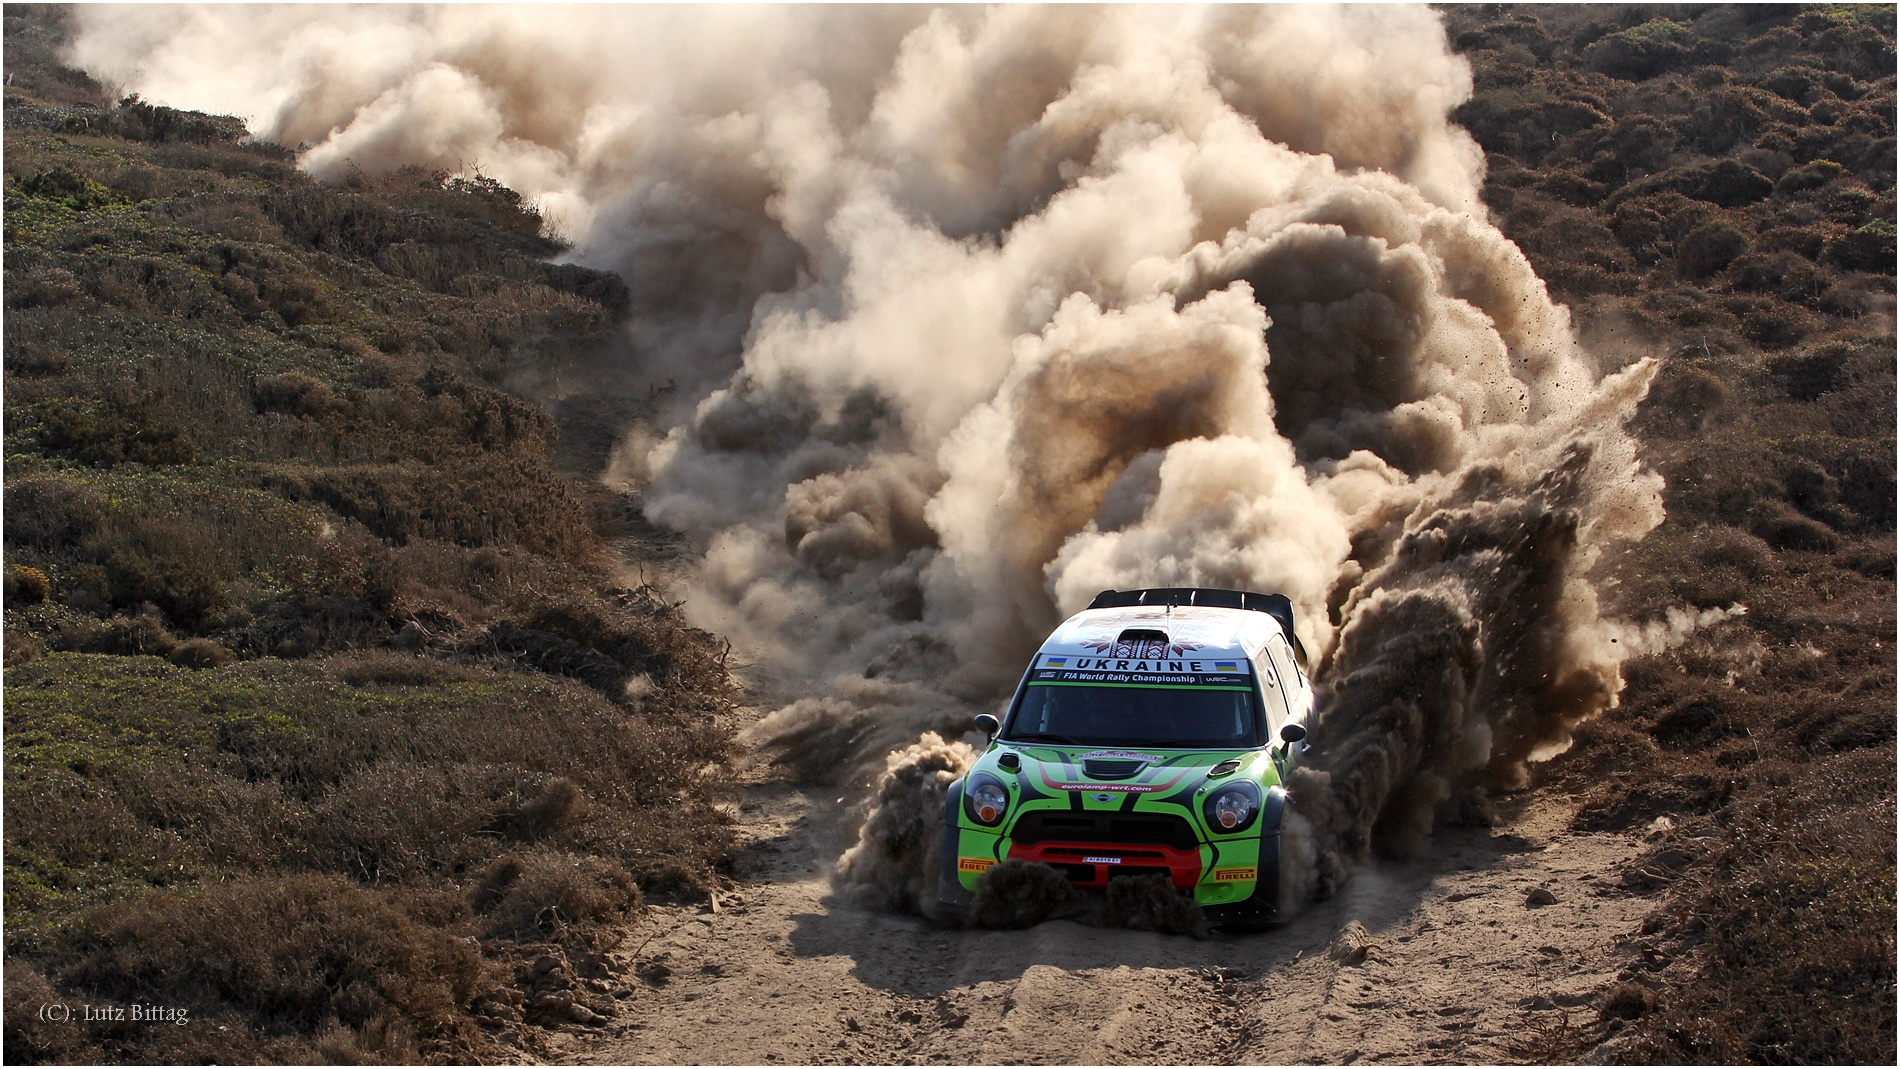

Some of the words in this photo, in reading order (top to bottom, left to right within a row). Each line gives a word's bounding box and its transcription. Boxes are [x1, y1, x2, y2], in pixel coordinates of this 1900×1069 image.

[1076, 659, 1203, 671] UKRAINE
[1063, 672, 1078, 680] FIA
[1079, 673, 1104, 681] World
[1106, 673, 1130, 683] Rally
[1132, 674, 1196, 684] Championship
[1061, 783, 1152, 792] eurolamp-wrt.com
[959, 858, 995, 871] PIREL
[1215, 868, 1255, 880] PIRELLI
